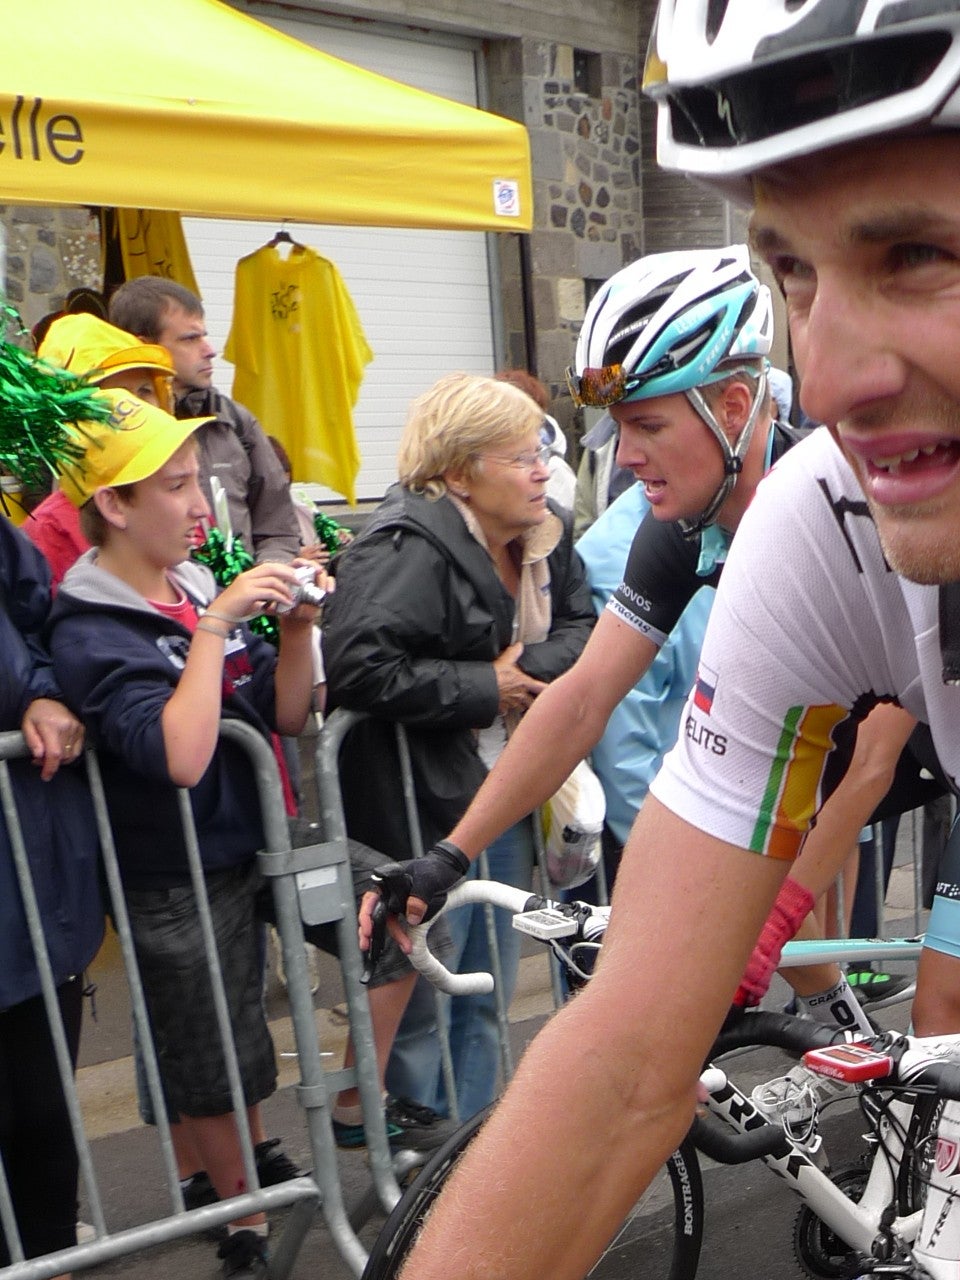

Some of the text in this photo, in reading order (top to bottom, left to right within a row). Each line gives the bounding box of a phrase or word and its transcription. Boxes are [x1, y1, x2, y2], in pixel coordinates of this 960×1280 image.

[0, 94, 84, 165] lle
[808, 981, 847, 1007] CRAFT
[672, 1148, 694, 1236] BONTRAGER
[926, 1186, 959, 1250] TREK
